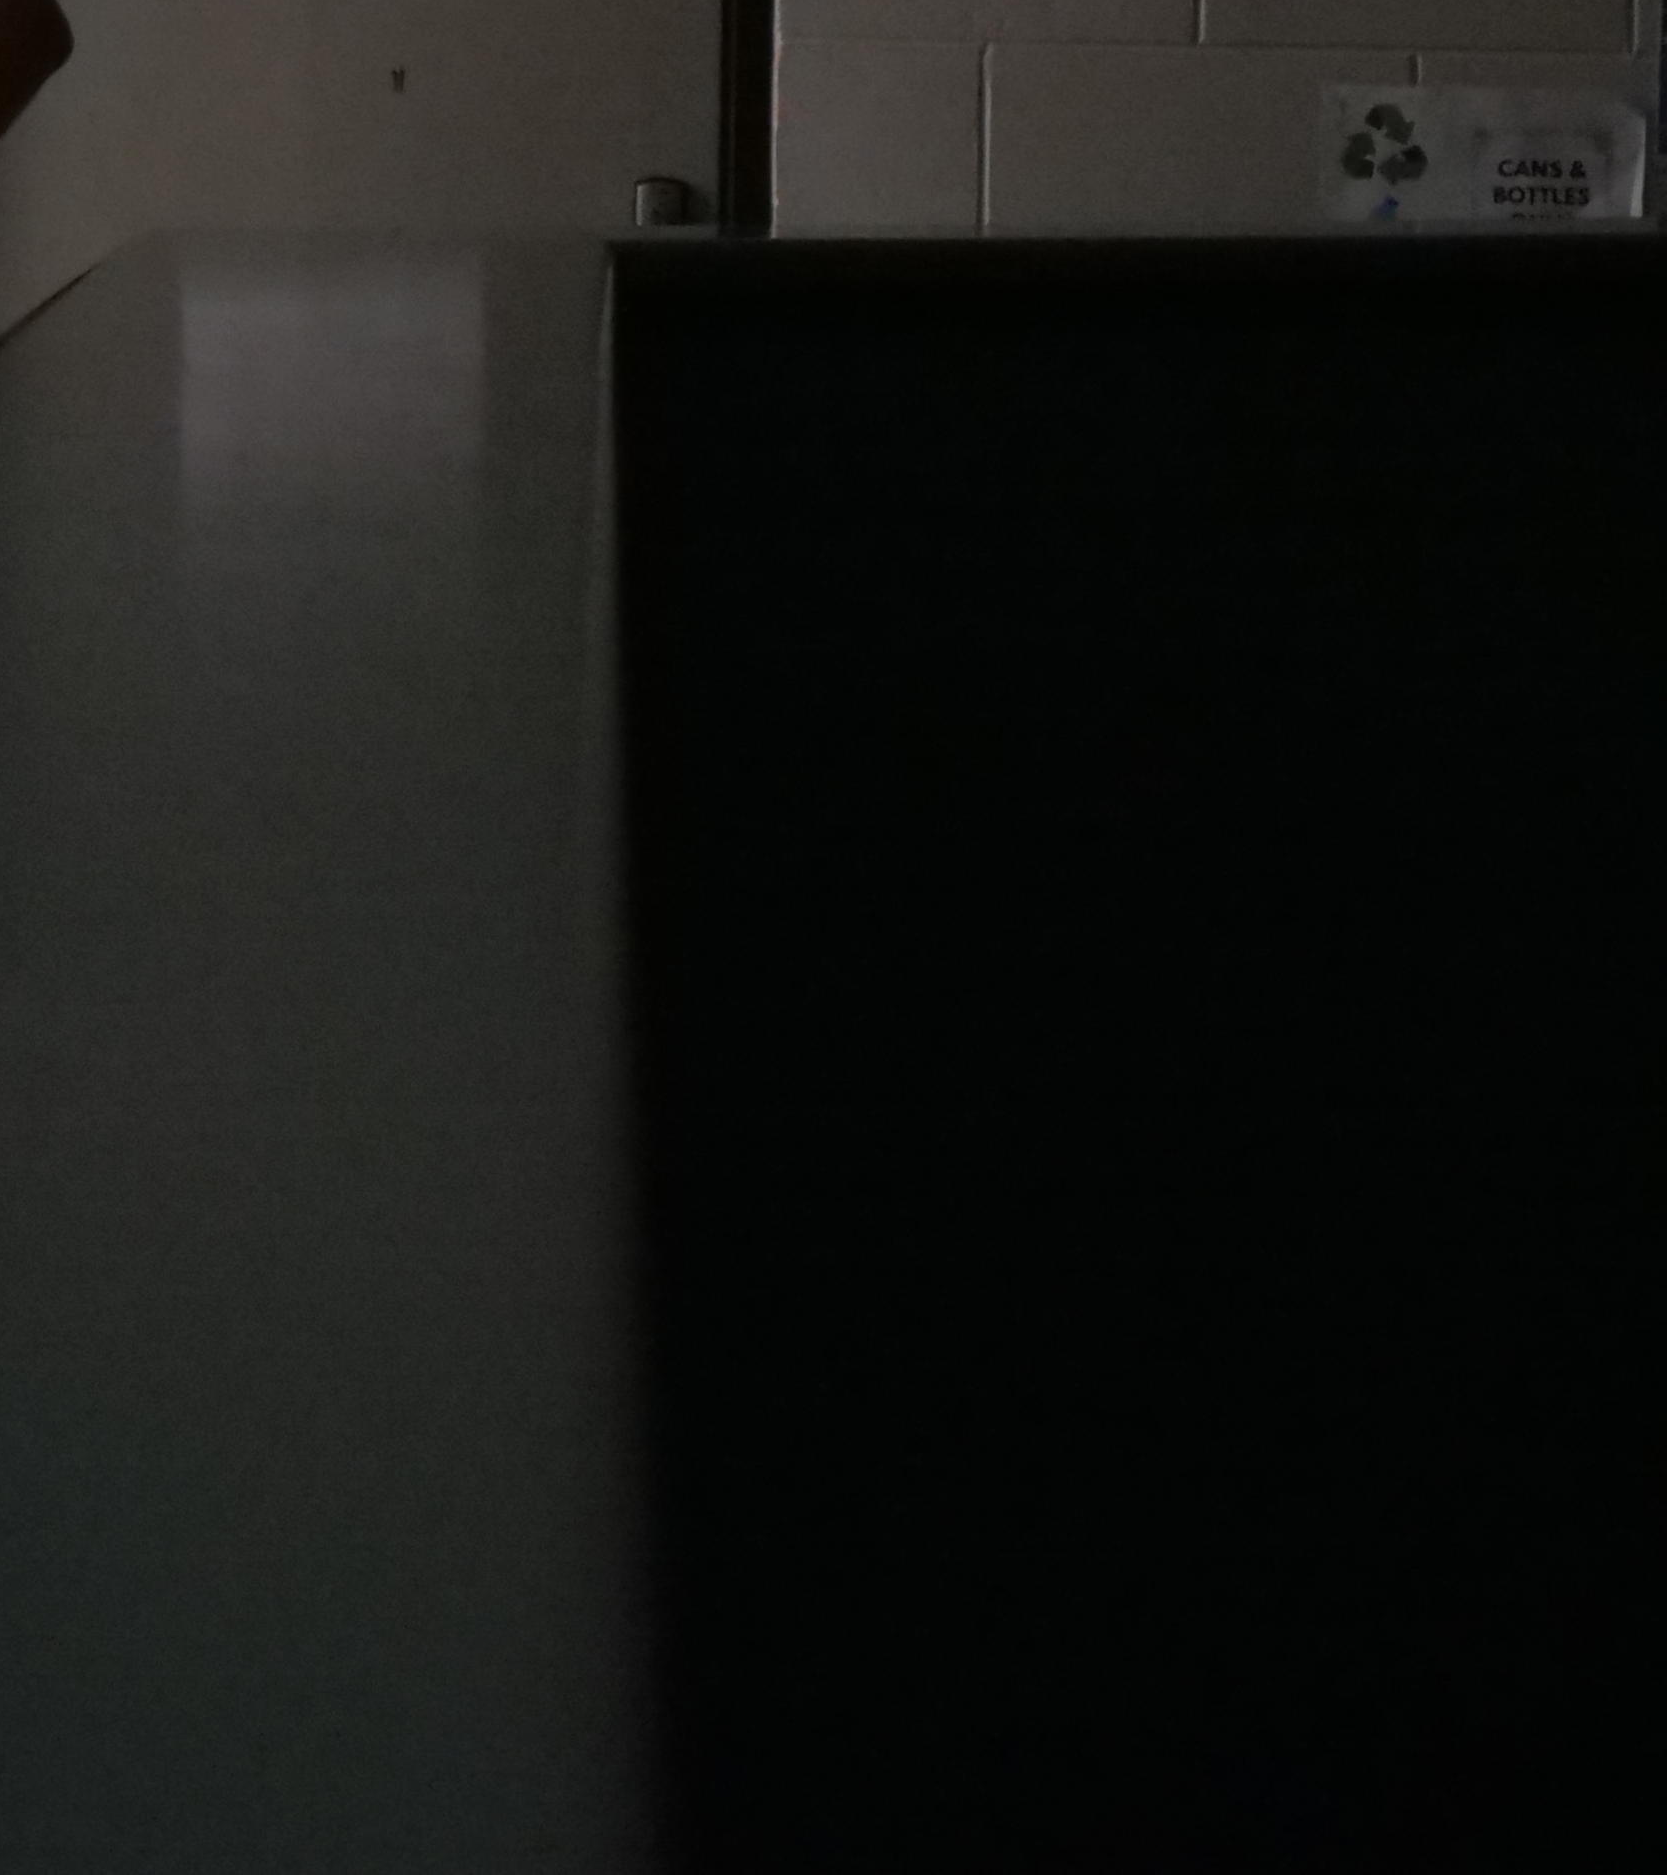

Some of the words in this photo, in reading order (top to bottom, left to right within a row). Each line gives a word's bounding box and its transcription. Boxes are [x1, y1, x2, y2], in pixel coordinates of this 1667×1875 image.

[1498, 159, 1562, 178] CANS
[1569, 159, 1586, 178] &
[1493, 186, 1589, 205] BOTTLES
